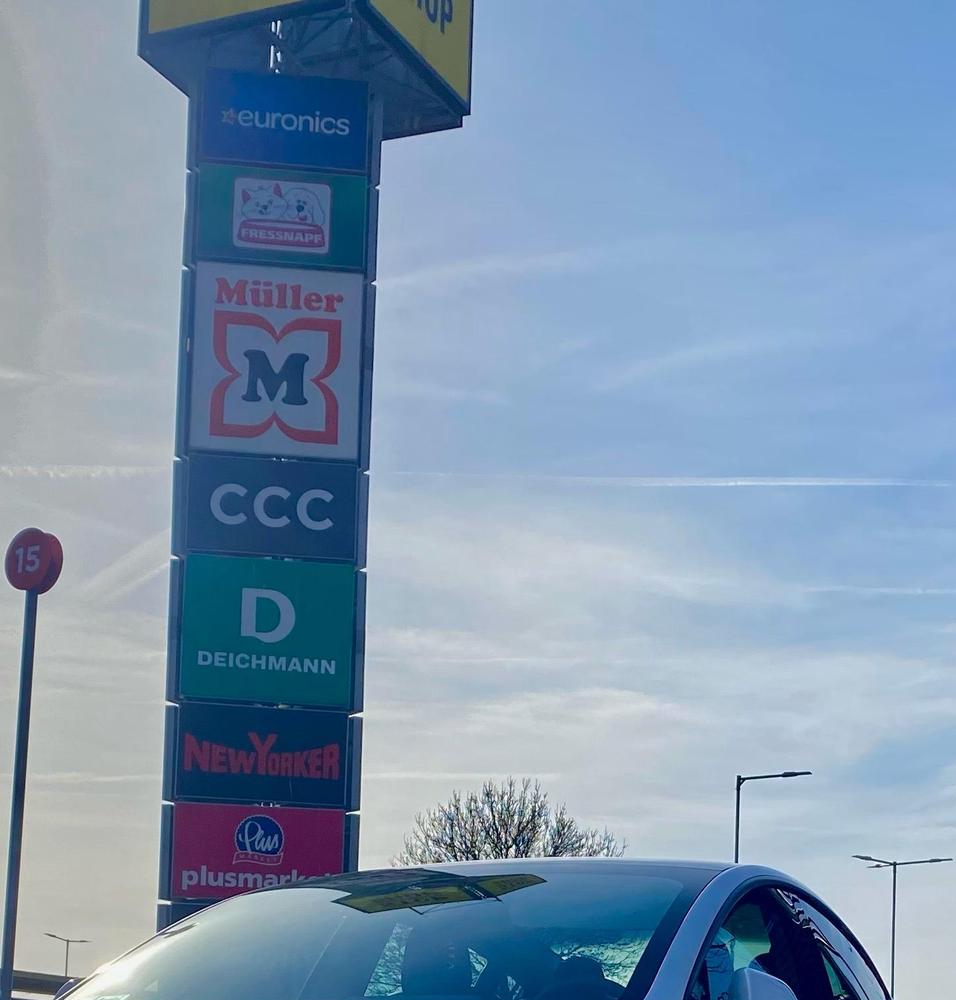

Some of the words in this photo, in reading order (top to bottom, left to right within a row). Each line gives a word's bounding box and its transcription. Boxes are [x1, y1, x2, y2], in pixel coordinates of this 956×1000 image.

[238, 109, 350, 135] euronics
[241, 228, 323, 244] FRESSNAPF
[215, 277, 344, 313] Müller
[241, 349, 310, 405] M
[210, 483, 334, 531] CCC
[15, 545, 41, 574] 15
[241, 588, 296, 643] D
[197, 650, 336, 674] DEICHMANN
